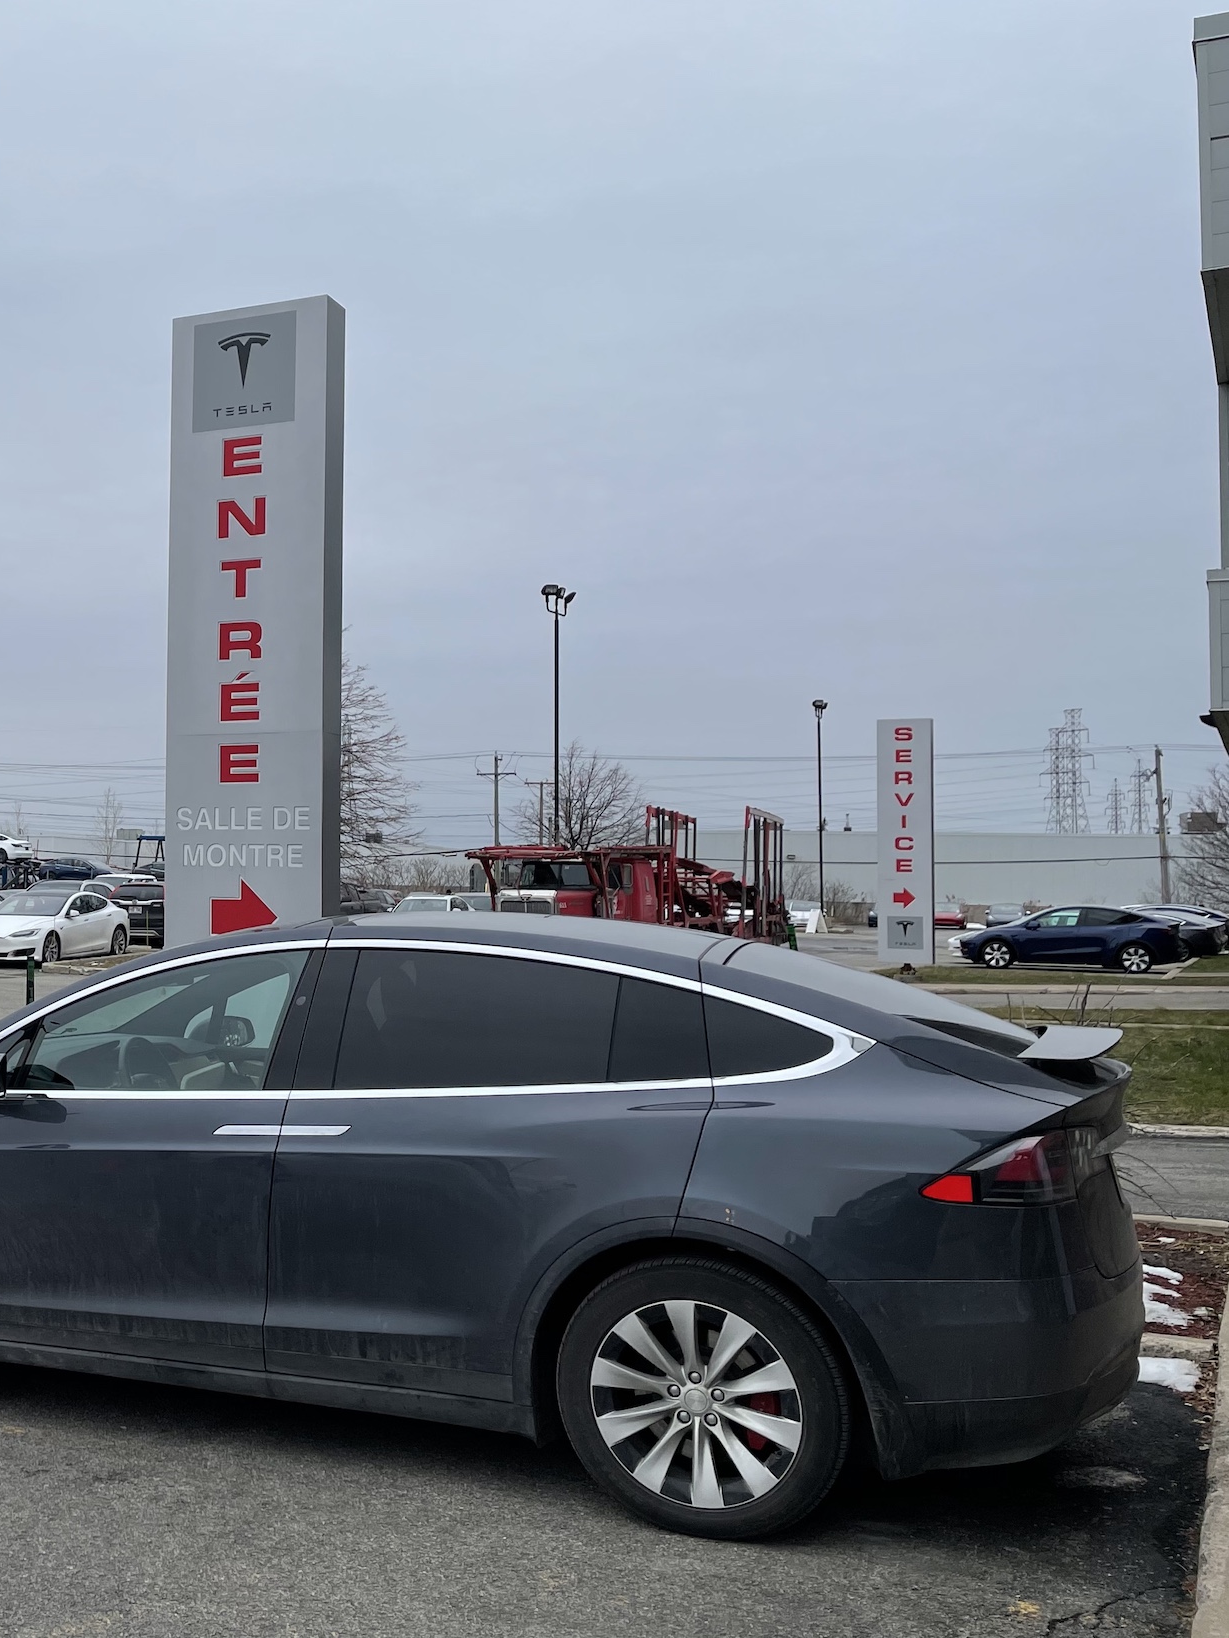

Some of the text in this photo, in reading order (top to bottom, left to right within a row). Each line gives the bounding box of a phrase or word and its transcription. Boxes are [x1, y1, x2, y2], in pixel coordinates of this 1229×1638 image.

[213, 402, 272, 418] TESLA
[217, 434, 267, 784] ENTRÉE
[894, 727, 915, 873] SERVICE
[175, 806, 311, 832] SALLE DE
[182, 843, 304, 868] MONTRE
